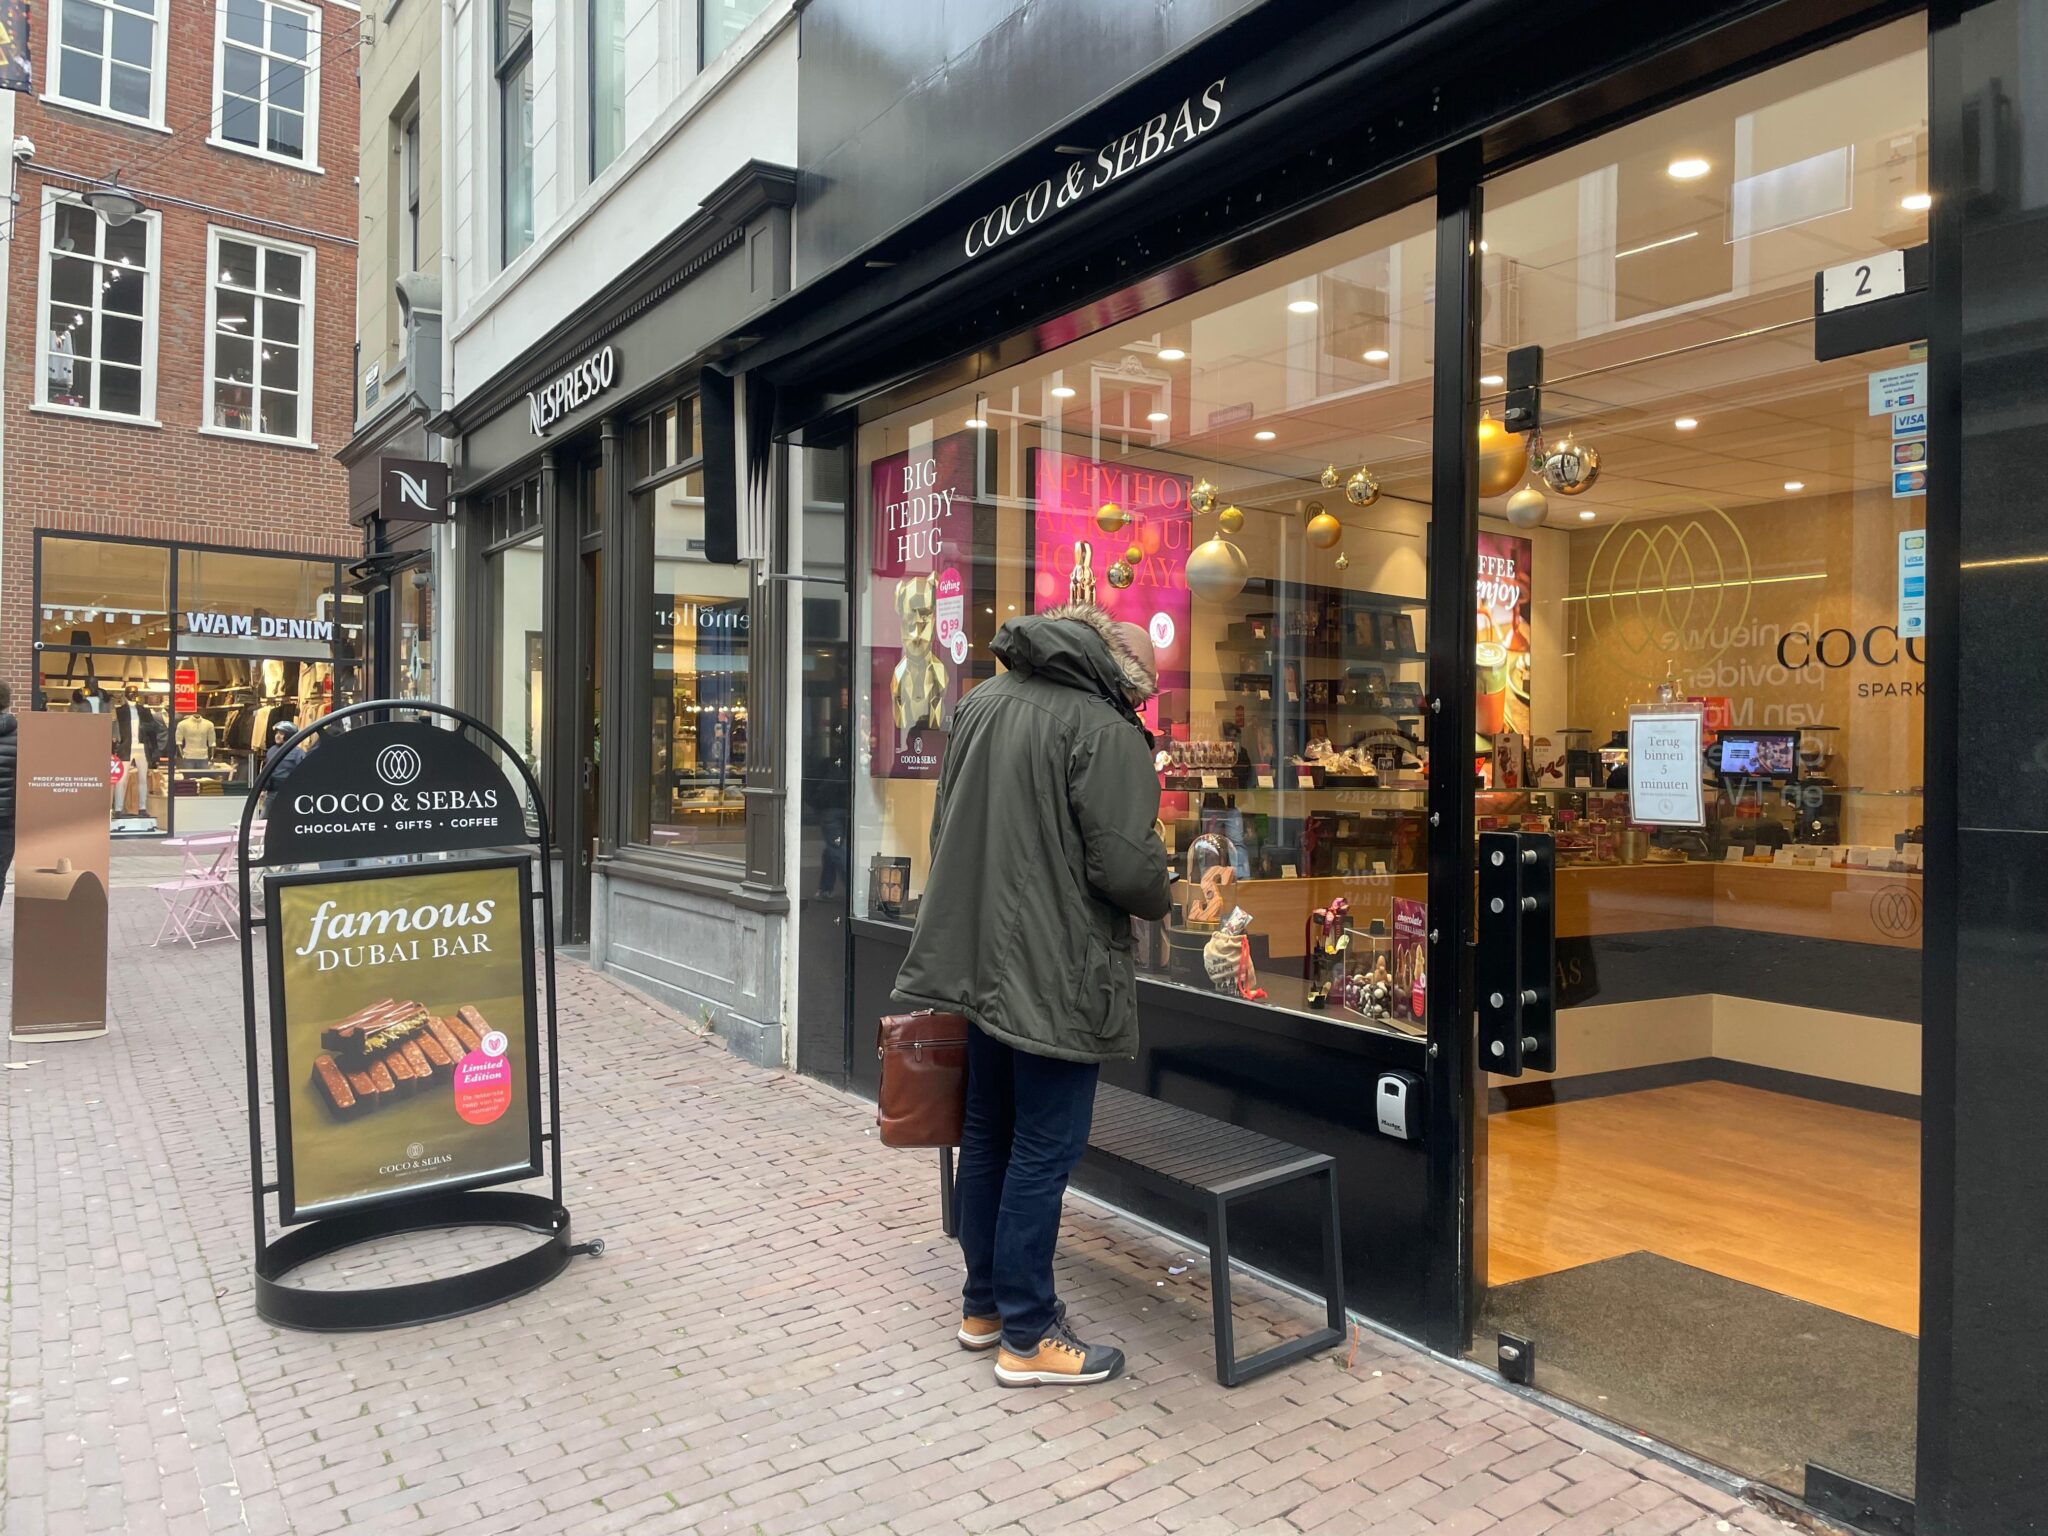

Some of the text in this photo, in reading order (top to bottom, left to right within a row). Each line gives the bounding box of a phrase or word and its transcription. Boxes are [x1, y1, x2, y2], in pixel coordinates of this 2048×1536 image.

[964, 76, 1227, 258] COCO & SEBAS
[1855, 265, 1872, 297] 2
[526, 345, 614, 437] NESPRESSO
[1899, 413, 1925, 427] VISA
[902, 458, 938, 494] BIG
[390, 470, 438, 511] N
[886, 487, 956, 531] TEDDY
[896, 527, 943, 563] HUG
[939, 580, 961, 594] Gifting
[186, 611, 333, 641] WAM DENIM
[1858, 681, 1926, 698] SPARK
[1648, 735, 1681, 749] Terug
[1644, 748, 1684, 761] binnen
[1661, 764, 1668, 775] 5
[1640, 778, 1689, 790] minuten
[294, 789, 498, 815] COCO & SEBAS
[294, 817, 498, 835] CHOCOLATE GIFTS COFFEE
[295, 899, 496, 956] famous
[1397, 911, 1423, 927] chocolate
[316, 933, 493, 972] DUBAI BAR
[462, 1059, 503, 1074] Limited
[464, 1072, 502, 1084] Edition
[379, 1162, 411, 1175] COCO
[413, 1160, 420, 1169] &
[421, 1153, 453, 1167] SEBAS
